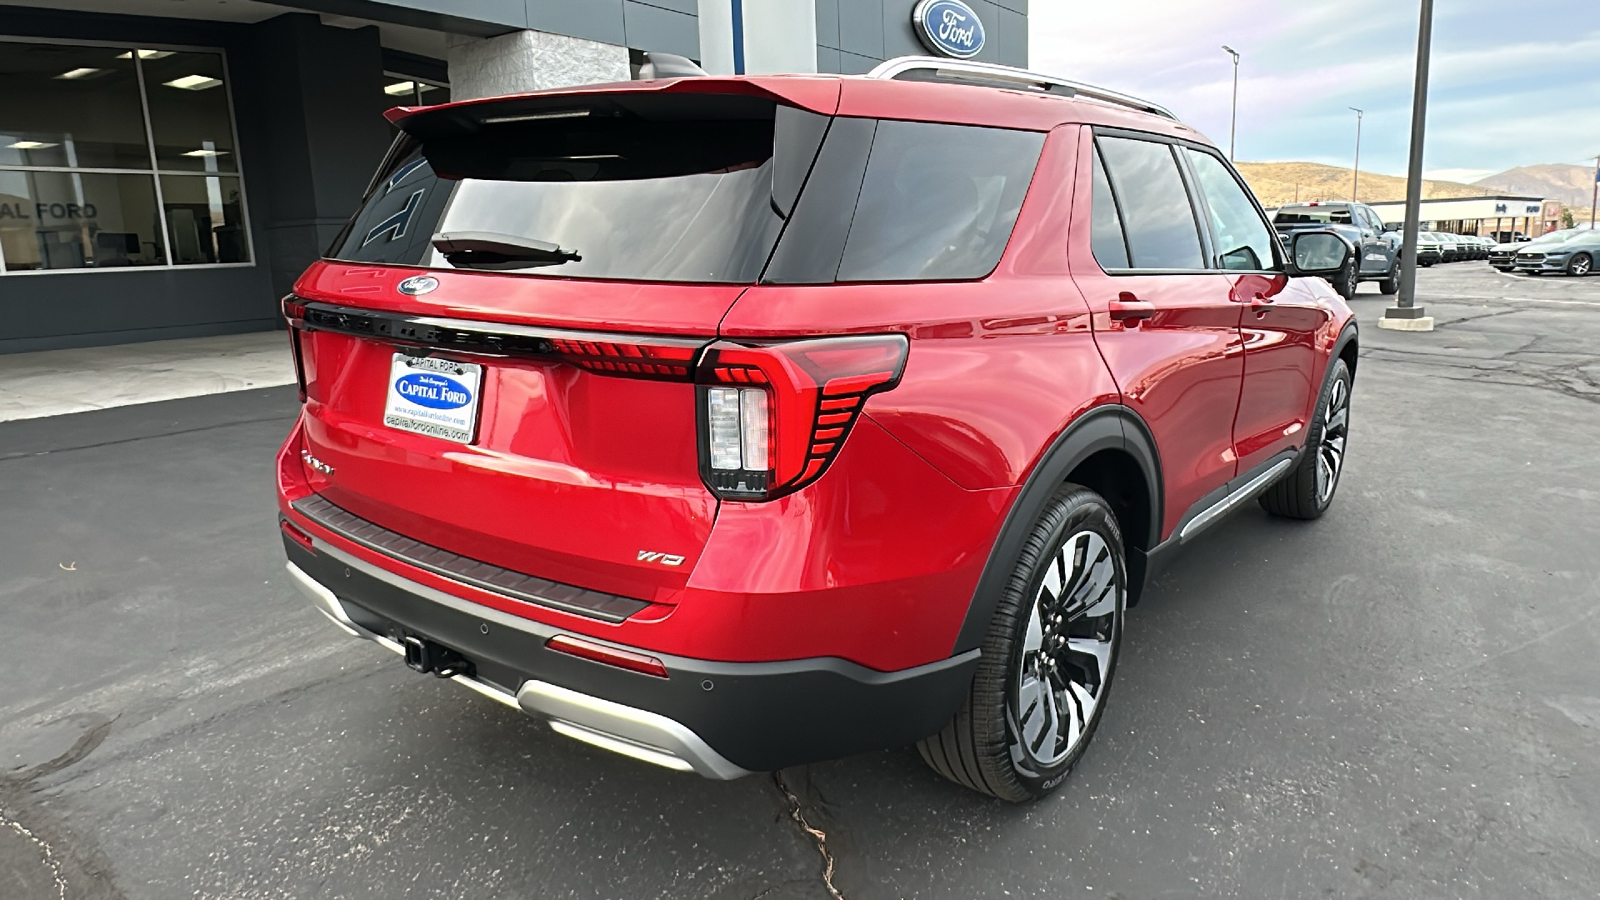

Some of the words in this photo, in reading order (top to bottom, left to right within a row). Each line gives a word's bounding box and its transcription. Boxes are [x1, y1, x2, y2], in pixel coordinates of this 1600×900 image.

[939, 9, 974, 47] Ford
[0, 203, 29, 219] AL
[36, 203, 97, 219] FORD
[411, 357, 437, 369] CAPITAL
[399, 380, 438, 400] CAPITAL
[440, 386, 467, 404] FORD
[386, 415, 469, 441] capitalfordonline.com
